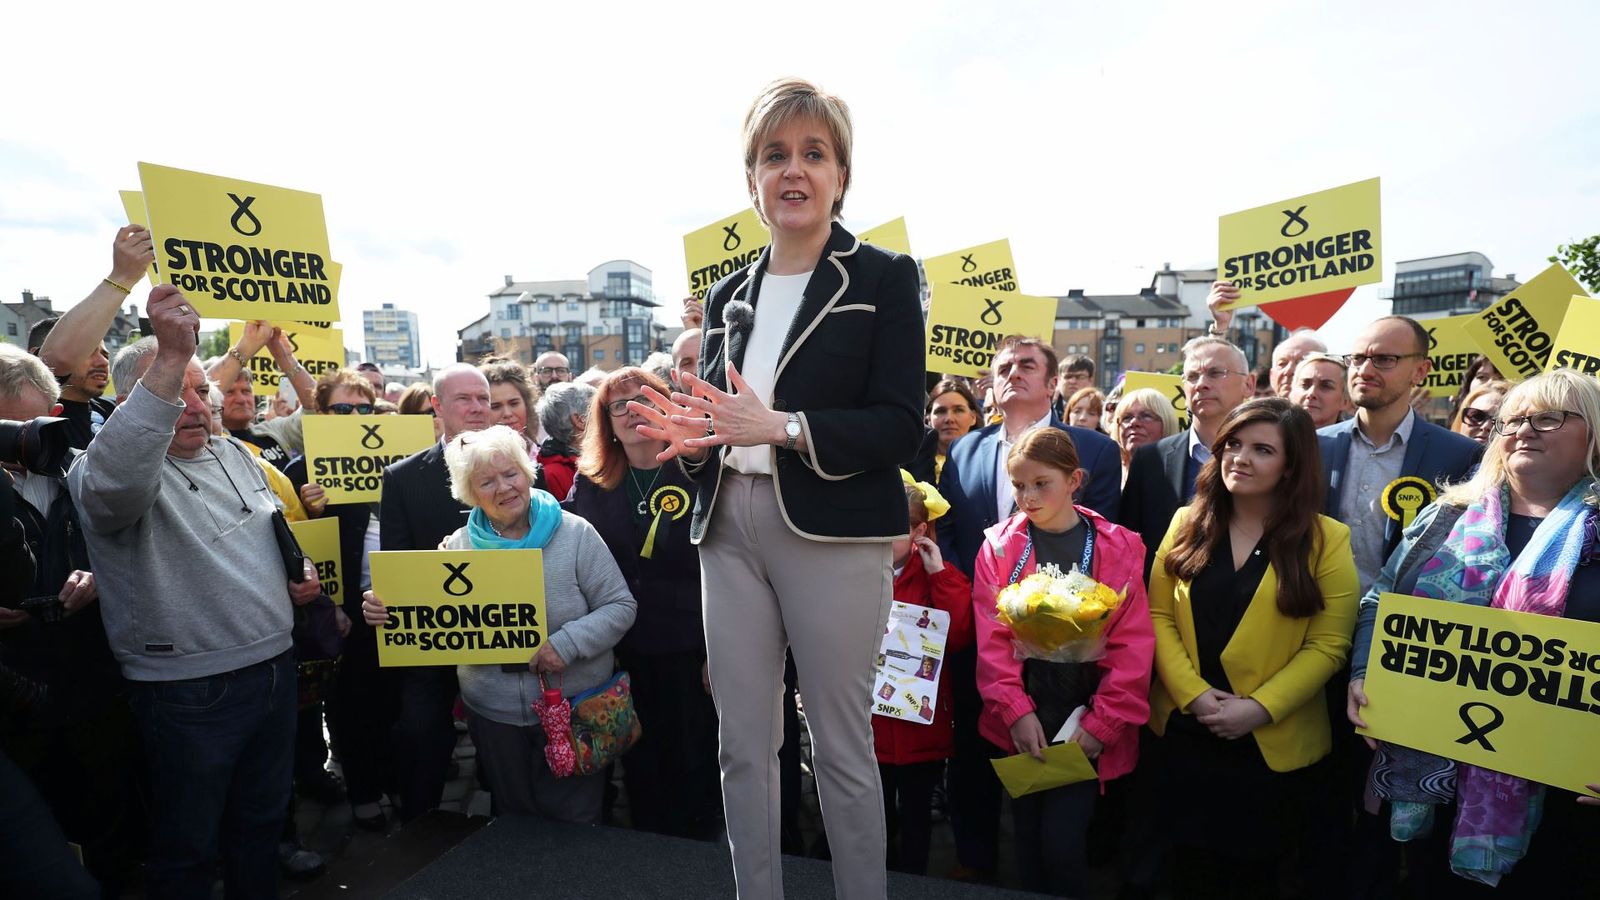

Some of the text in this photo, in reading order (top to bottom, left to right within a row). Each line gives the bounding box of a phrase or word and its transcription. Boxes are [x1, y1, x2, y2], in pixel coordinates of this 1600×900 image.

[164, 238, 328, 280] STRONGER
[1224, 229, 1373, 278] STRONGER
[1230, 253, 1374, 291] OR SCOTLAND
[170, 273, 332, 305] FOR SCOTLAND
[1482, 312, 1506, 337] FOR
[929, 345, 952, 358] FOR
[383, 604, 538, 630] STRONGER
[384, 630, 541, 651] FOR SCOTLAND
[1383, 613, 1568, 667] SCOTLAND
[877, 703, 896, 715] SNP
